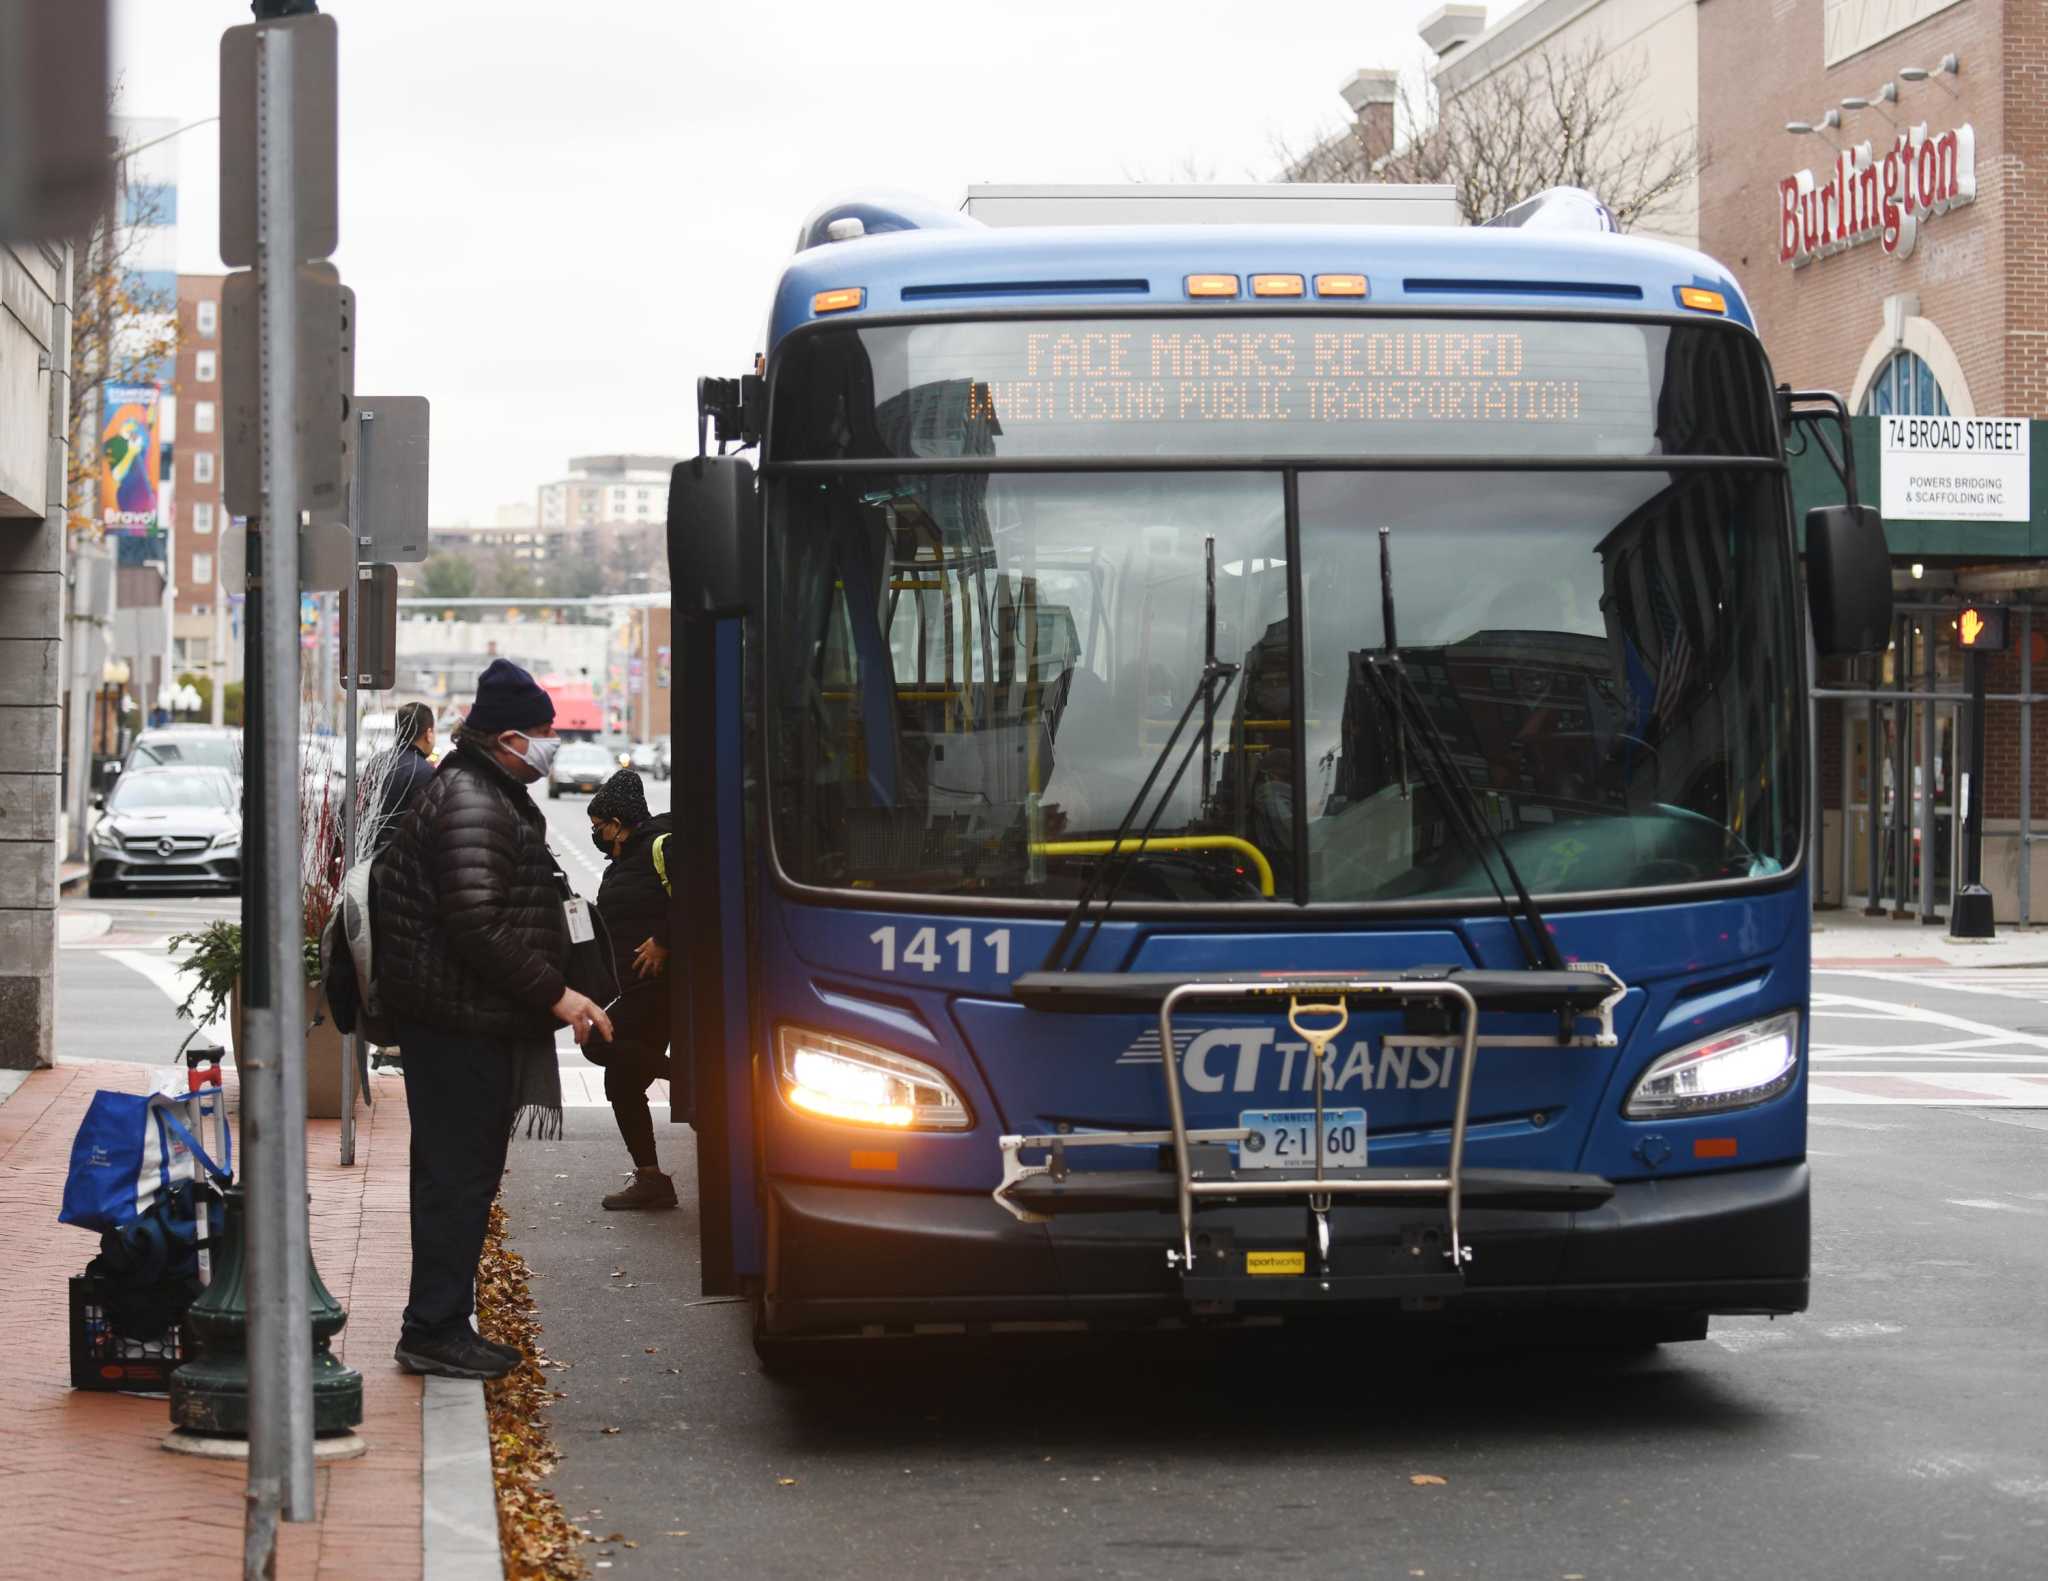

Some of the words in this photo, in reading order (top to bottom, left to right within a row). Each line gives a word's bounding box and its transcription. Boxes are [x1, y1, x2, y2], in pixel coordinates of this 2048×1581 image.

[1779, 124, 1970, 264] Burlington
[1026, 333, 1132, 376] FACE
[1151, 333, 1295, 376] MASKS
[1313, 333, 1525, 376] REQUIRED
[1068, 381, 1165, 419] USING
[1179, 381, 1291, 419] PUBLIC
[1306, 381, 1581, 419] TRANSPORTATION
[1889, 420, 1904, 448] 74
[1909, 420, 1961, 449] BROAD
[1966, 421, 2021, 450] STREET
[1910, 477, 1952, 488] POWERS
[1954, 477, 2002, 489] BRIDGING
[1915, 492, 1985, 504] SCAFFOLDING
[870, 926, 1010, 973] 1411
